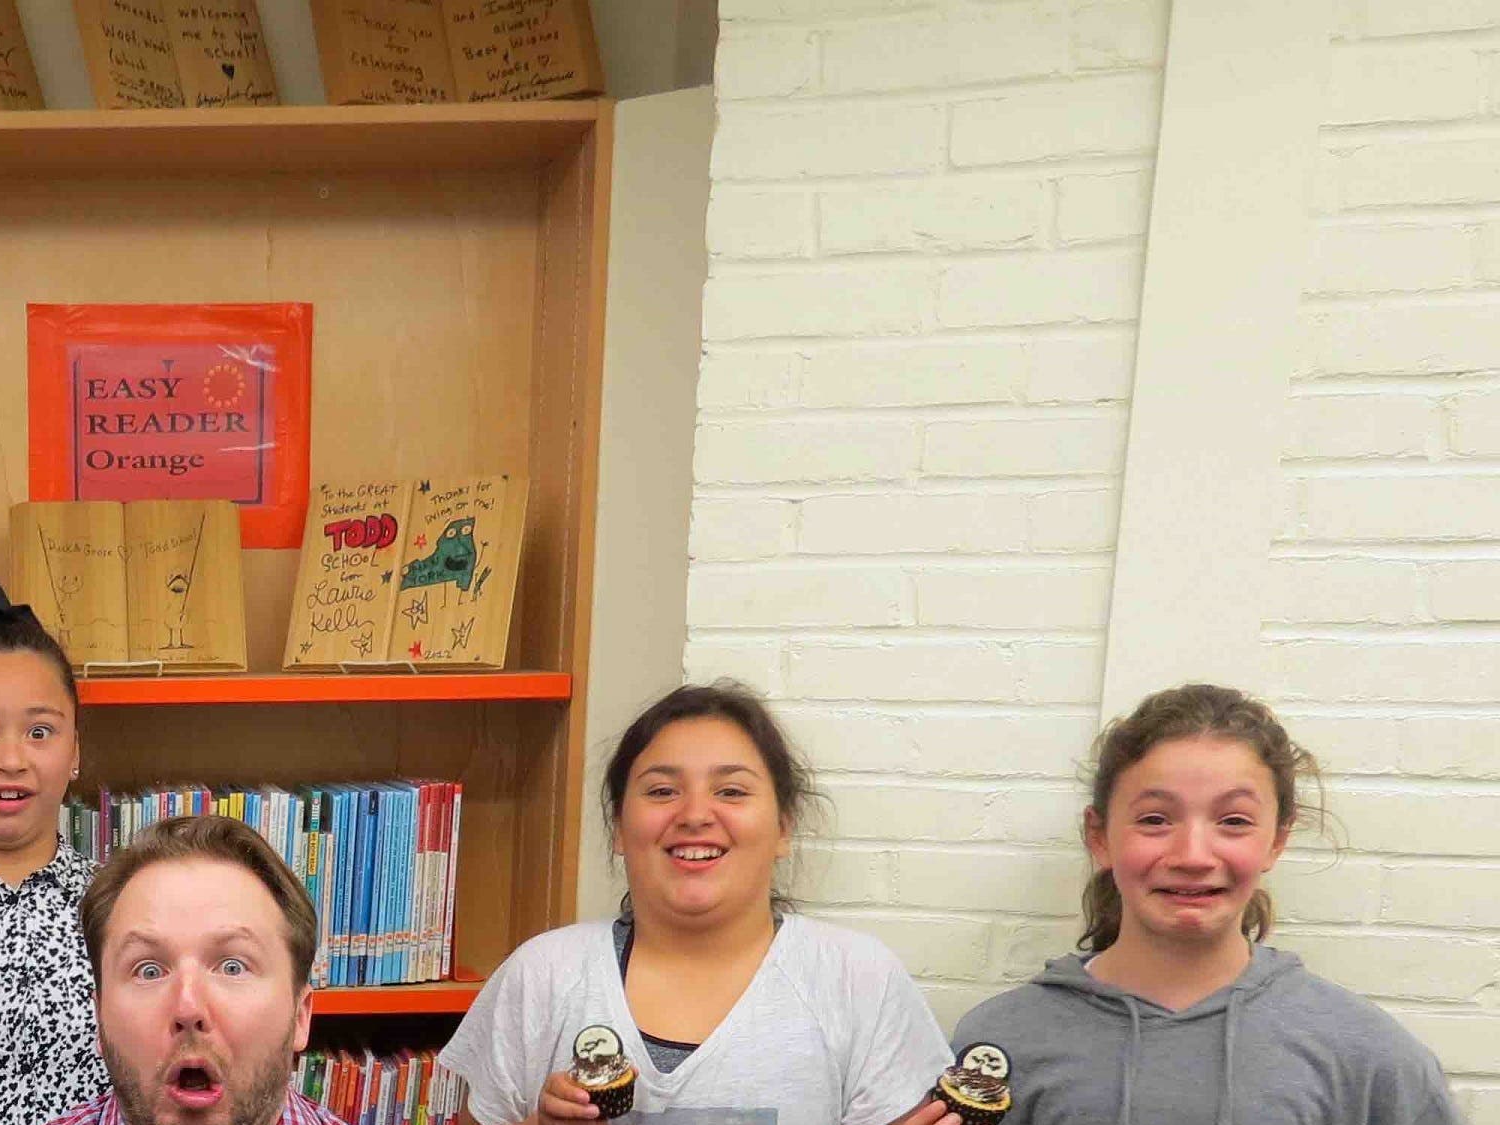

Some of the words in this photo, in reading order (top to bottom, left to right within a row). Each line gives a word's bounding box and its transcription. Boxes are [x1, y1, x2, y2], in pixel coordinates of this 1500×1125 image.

[86, 377, 183, 400] EASY
[86, 412, 250, 435] READER
[85, 449, 205, 476] Orange
[322, 487, 336, 501] To
[337, 487, 355, 500] the
[357, 484, 398, 498] GREAT
[430, 486, 470, 505] Thanks
[477, 480, 493, 492] for
[373, 499, 390, 511] at
[324, 512, 398, 552] TODD
[321, 552, 380, 573] SCHOOL
[410, 569, 446, 584] YORK
